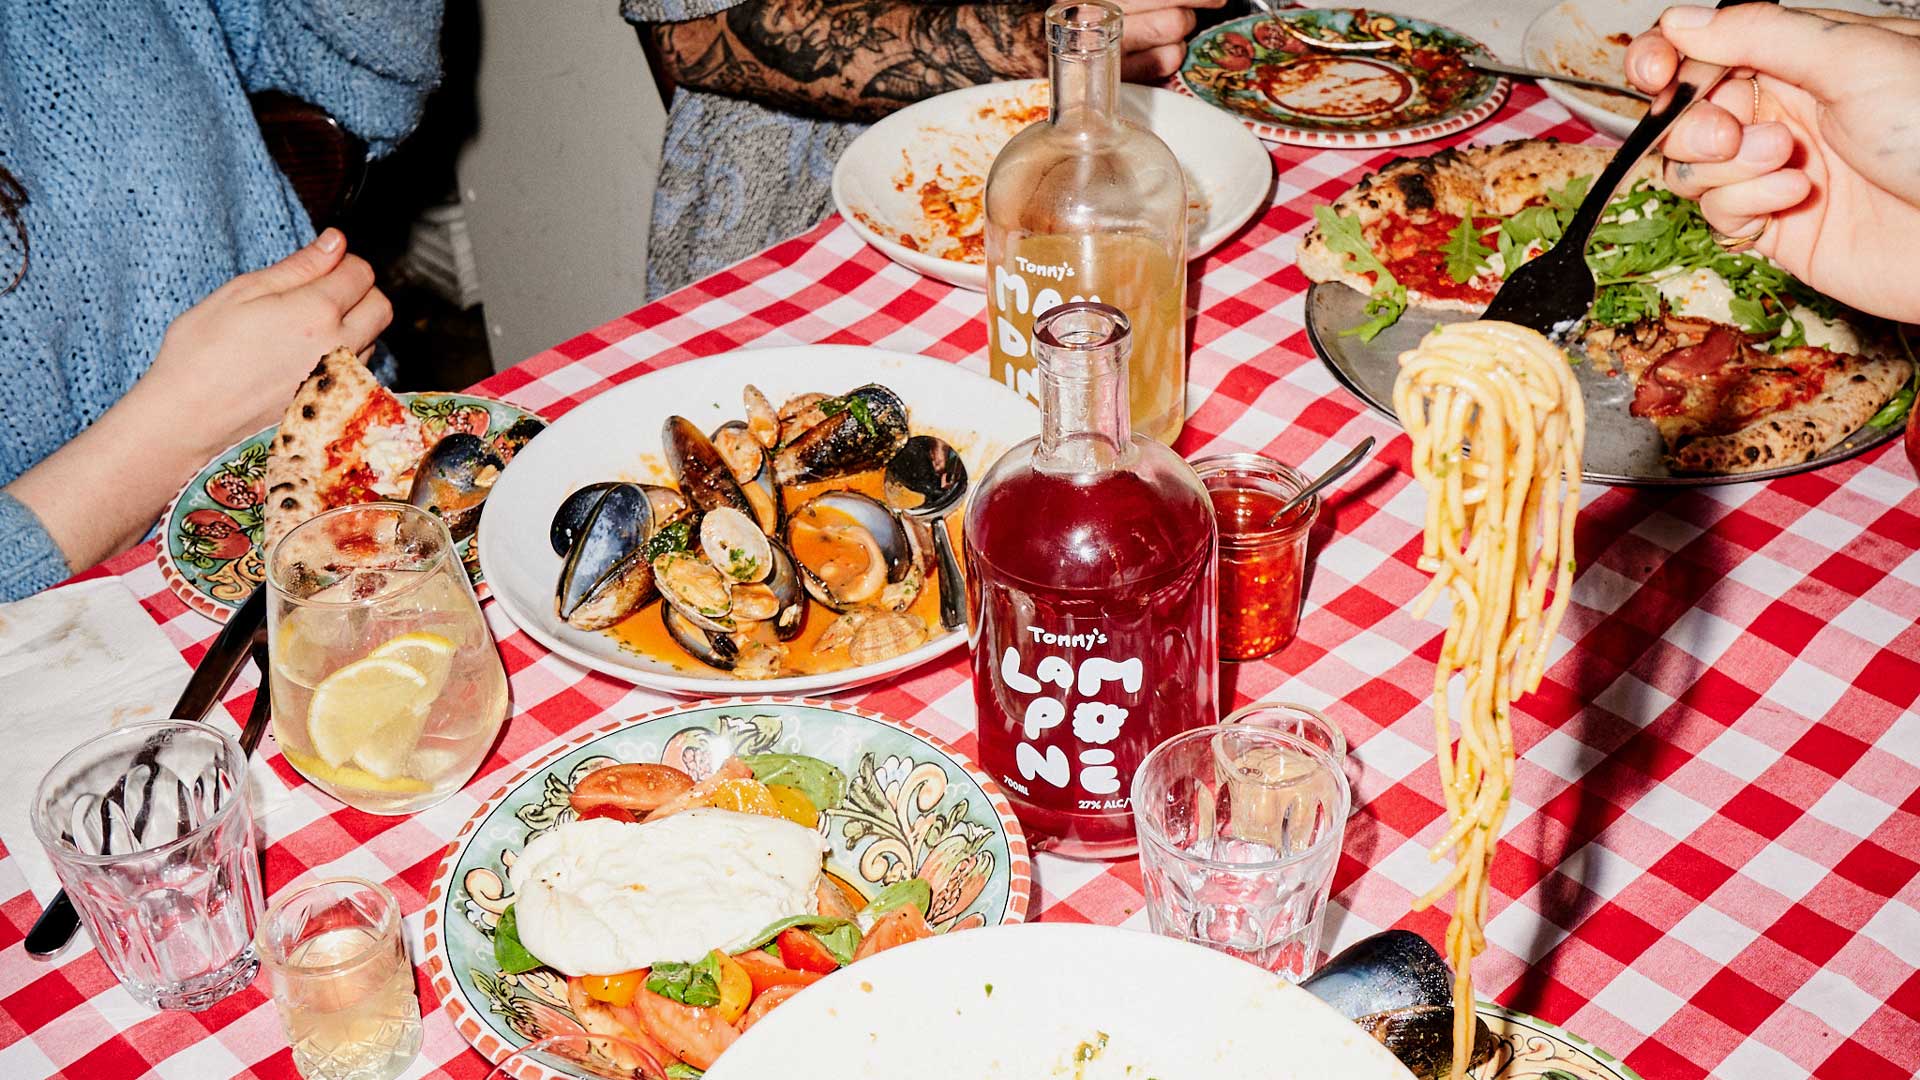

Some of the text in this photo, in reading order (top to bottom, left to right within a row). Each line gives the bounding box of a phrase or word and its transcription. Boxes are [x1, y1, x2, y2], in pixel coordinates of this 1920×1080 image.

[995, 264, 1102, 318] MA
[1015, 256, 1076, 282] Tommy's
[1026, 626, 1108, 651] Tommy's
[1001, 646, 1144, 697] LAM
[1024, 696, 1129, 745] PO
[1016, 742, 1121, 794] NE
[1078, 800, 1102, 810] 27%
